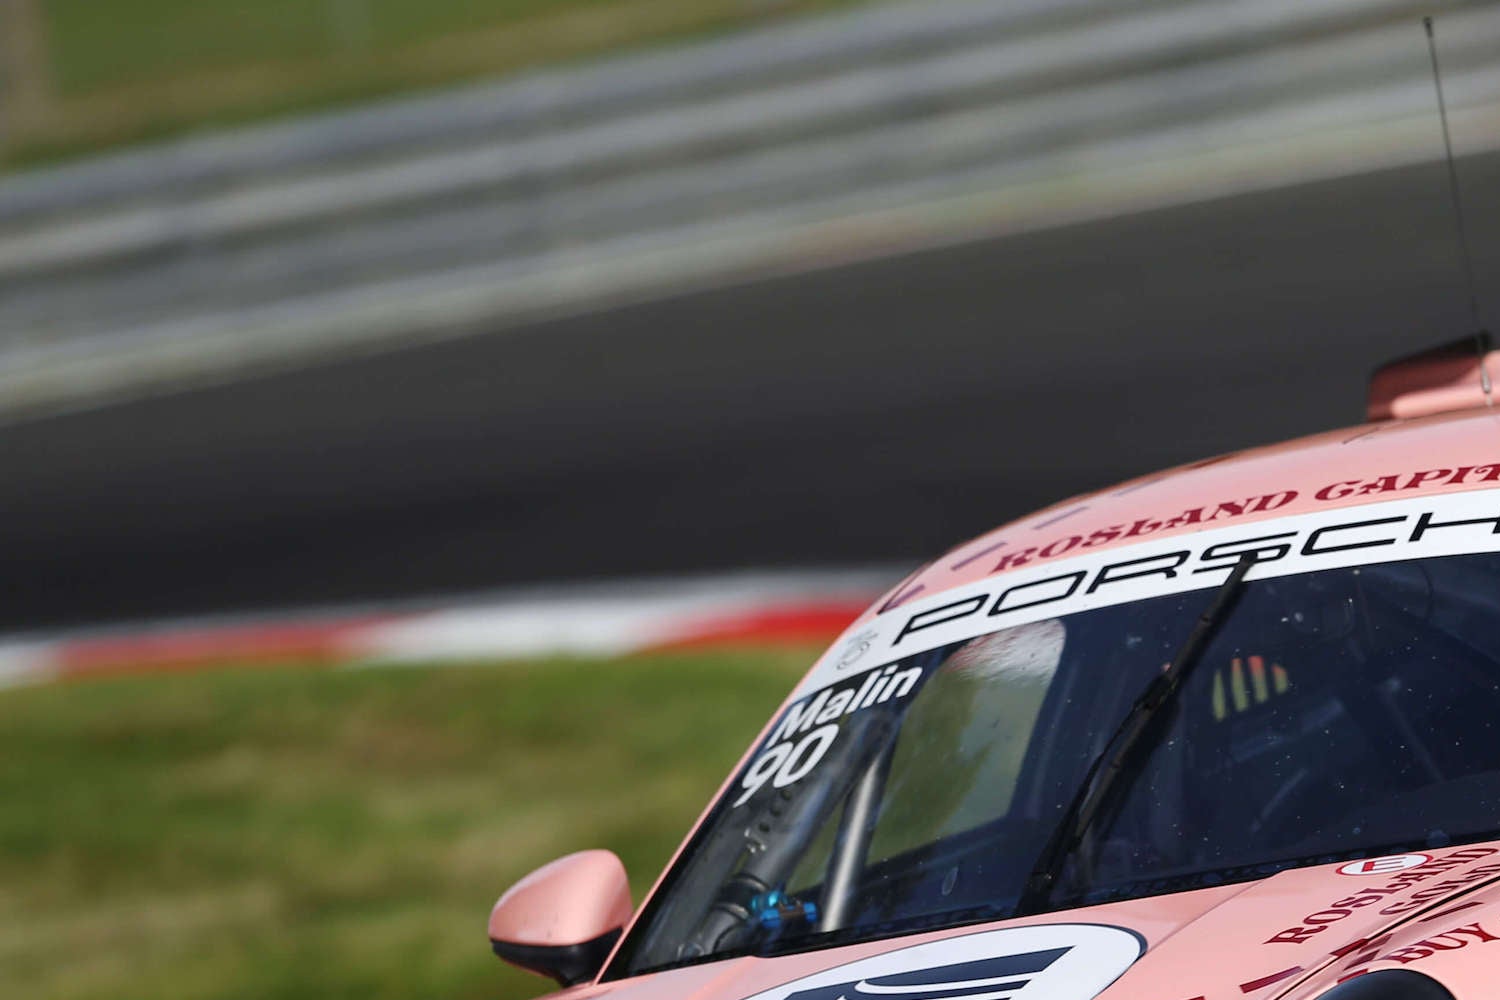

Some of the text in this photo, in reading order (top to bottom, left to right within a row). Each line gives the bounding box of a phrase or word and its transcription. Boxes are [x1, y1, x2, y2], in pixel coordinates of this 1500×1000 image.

[991, 489, 1299, 573] ROSLAND
[766, 664, 922, 750] Malin
[733, 723, 840, 808] 90
[1263, 847, 1499, 946] ROSLAND
